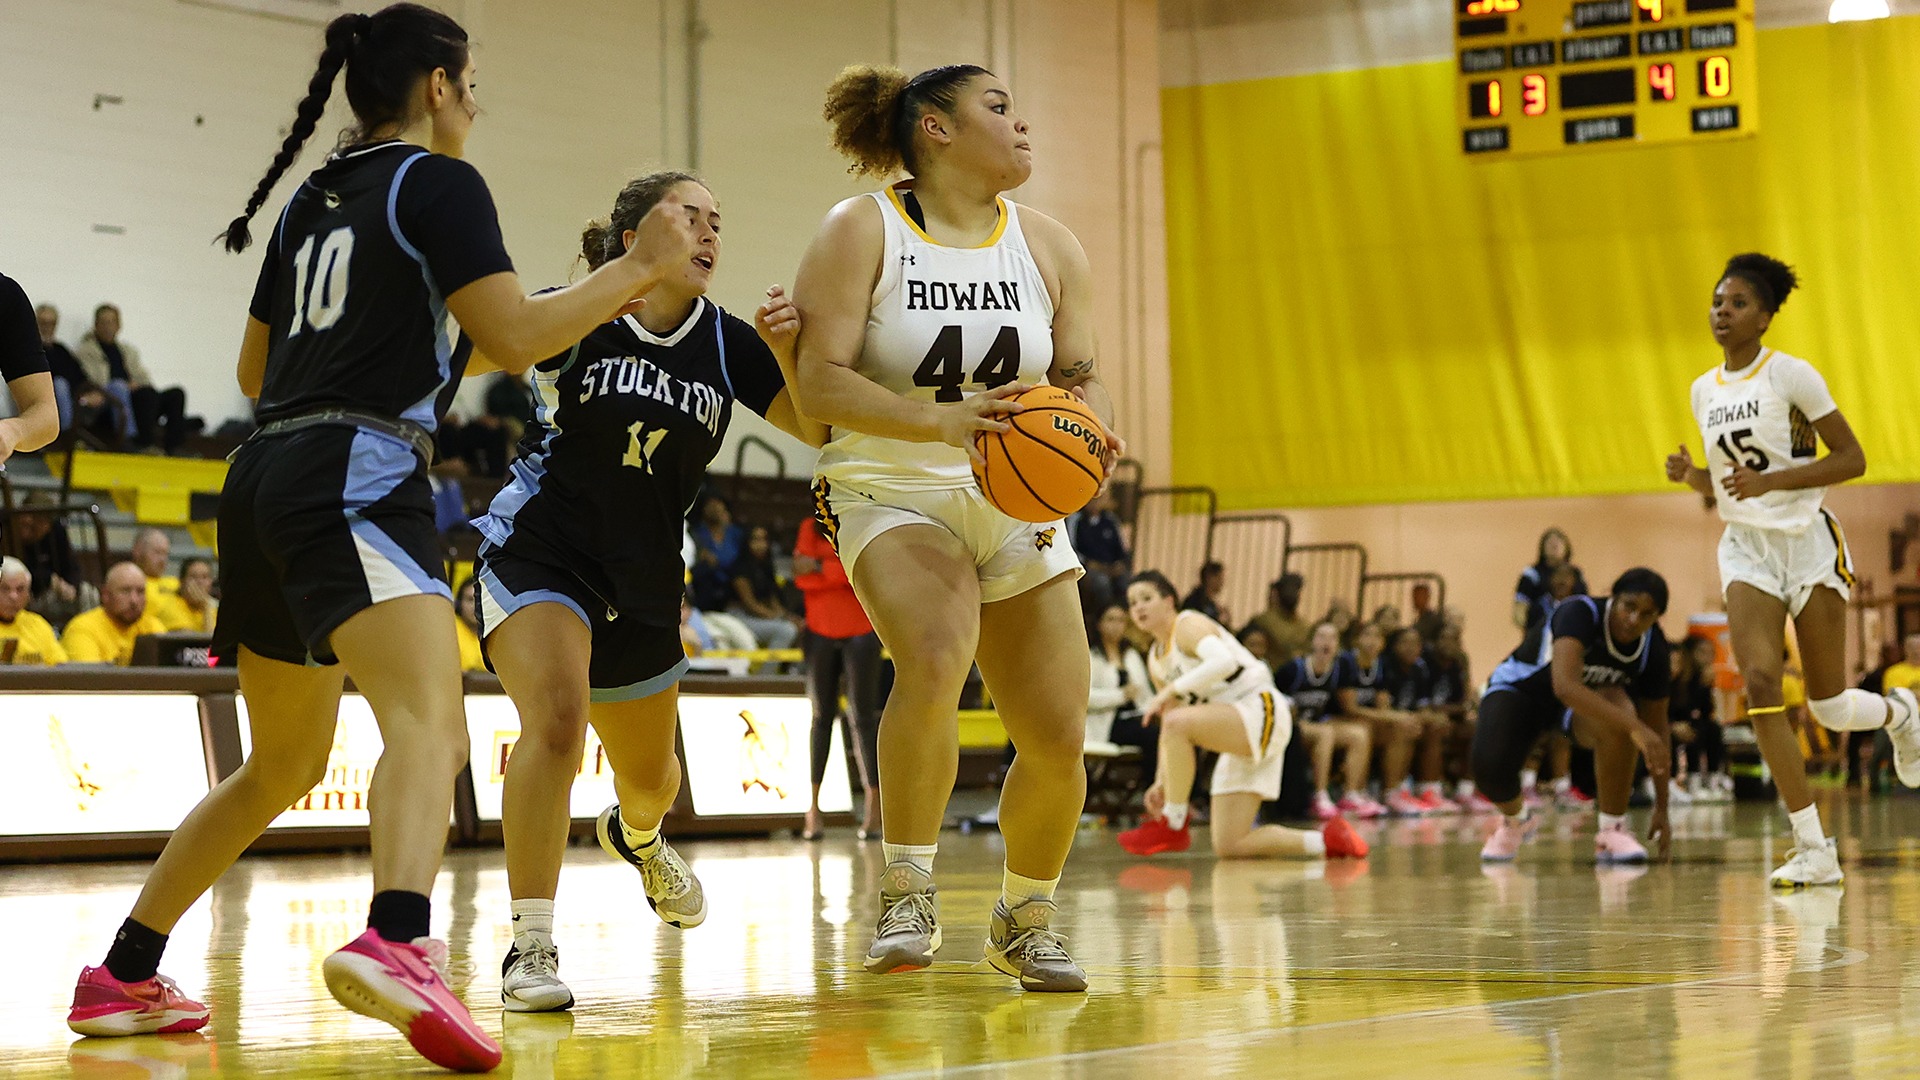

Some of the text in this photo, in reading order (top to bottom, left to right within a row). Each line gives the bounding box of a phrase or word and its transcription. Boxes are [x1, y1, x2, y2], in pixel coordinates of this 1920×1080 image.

[1522, 74, 1547, 116] 3
[1649, 63, 1675, 100] 4
[1705, 56, 1730, 97] 0
[1487, 80, 1501, 117] 1
[287, 226, 356, 339] 10
[907, 279, 1021, 312] ROWAN
[912, 324, 1021, 403] 44
[579, 355, 724, 438] STOCKTON
[1707, 400, 1760, 428] ROWAN
[1717, 427, 1770, 474] 15
